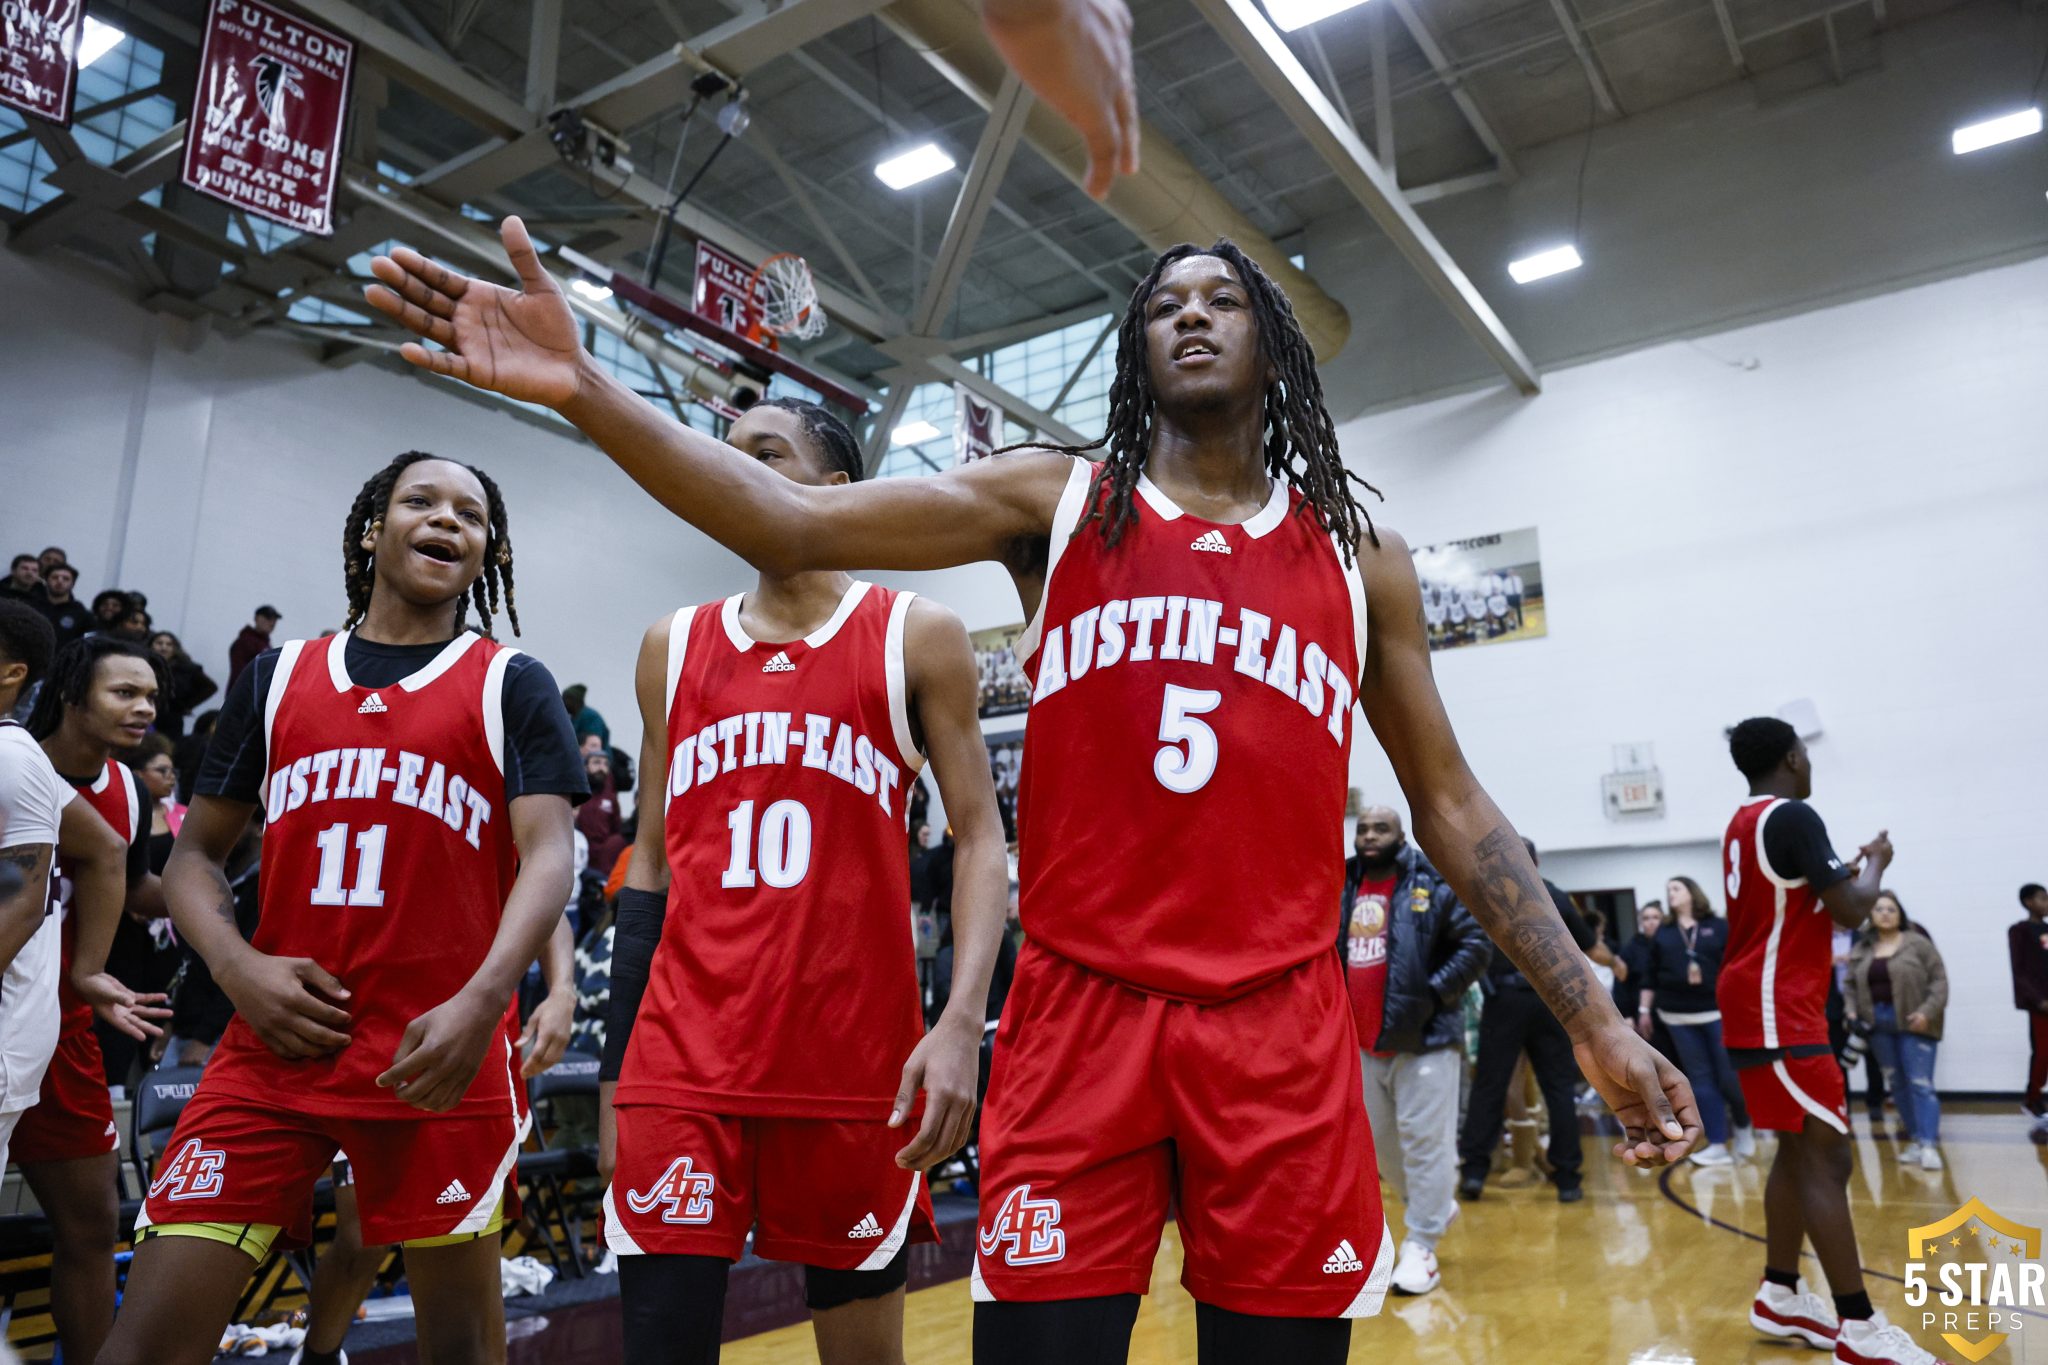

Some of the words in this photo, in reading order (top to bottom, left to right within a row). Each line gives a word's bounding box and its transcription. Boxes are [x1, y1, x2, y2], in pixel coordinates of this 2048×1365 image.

[217, 0, 346, 68] FULTON
[219, 20, 253, 41] BOYS
[258, 36, 339, 80] BASKETBALL
[220, 155, 298, 197] STATE
[1190, 540, 1232, 555] adidas
[762, 661, 796, 673] adidas
[1032, 595, 1352, 748] AUSTIN-EAST
[357, 703, 388, 714] adidas
[1153, 683, 1222, 794] 5
[670, 711, 899, 819] USTIN-EAST
[266, 747, 492, 851] USTIN-EAST
[310, 822, 388, 907] 11
[721, 799, 812, 889] 10
[1727, 838, 1741, 900] 3
[436, 1191, 472, 1205] adidas
[848, 1226, 884, 1239] adidas
[1322, 1259, 1363, 1274] adidas
